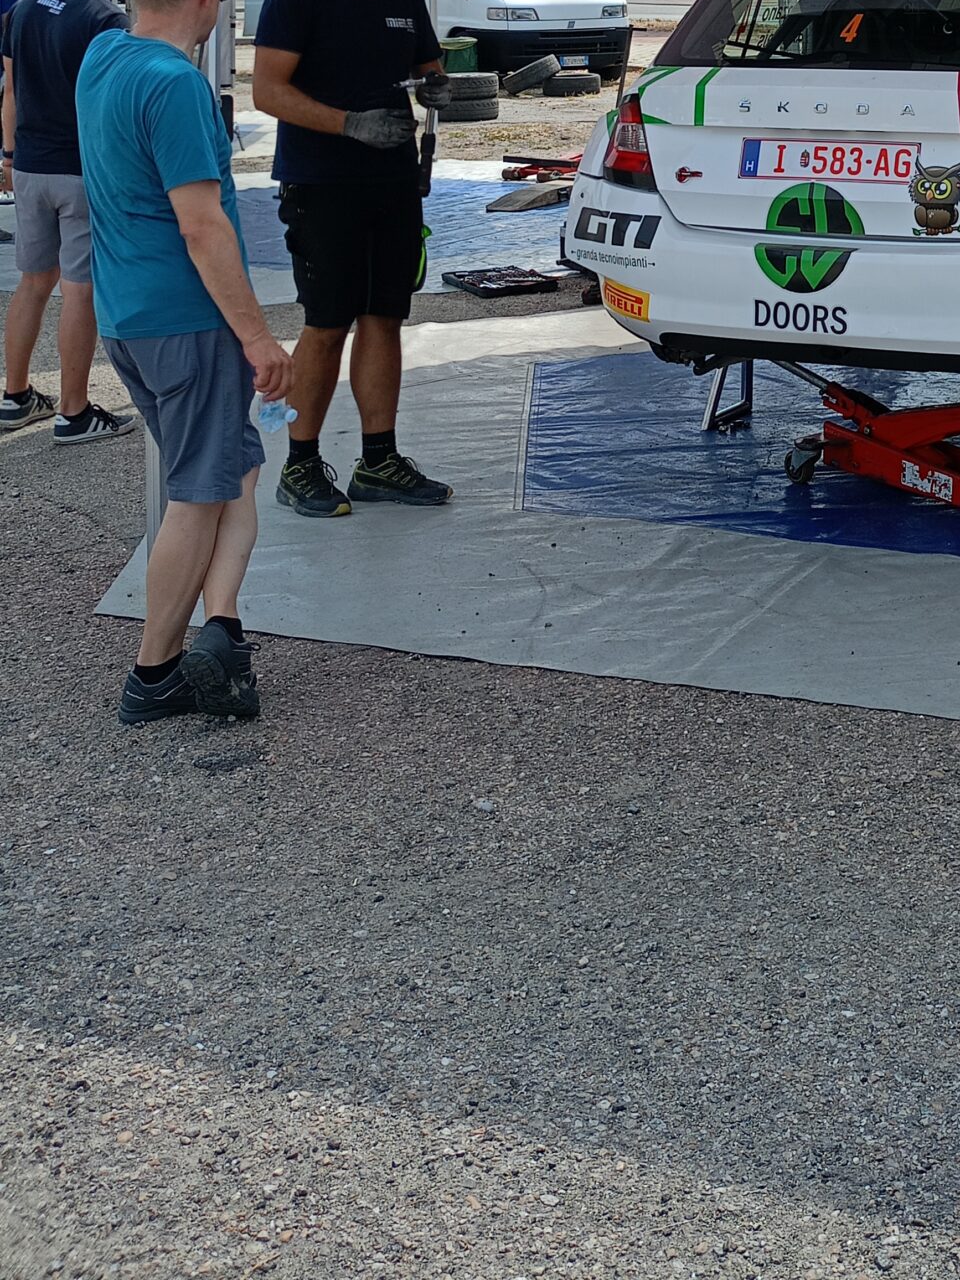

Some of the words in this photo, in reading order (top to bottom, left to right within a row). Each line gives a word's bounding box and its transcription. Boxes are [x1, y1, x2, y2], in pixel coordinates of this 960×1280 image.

[839, 13, 864, 43] 4
[745, 160, 753, 172] H
[773, 144, 787, 174] I
[811, 145, 913, 178] 583-AG
[574, 207, 662, 250] GTI
[576, 248, 599, 261] granda
[598, 252, 648, 269] tecnoimpianti
[754, 299, 848, 335] DOORS
